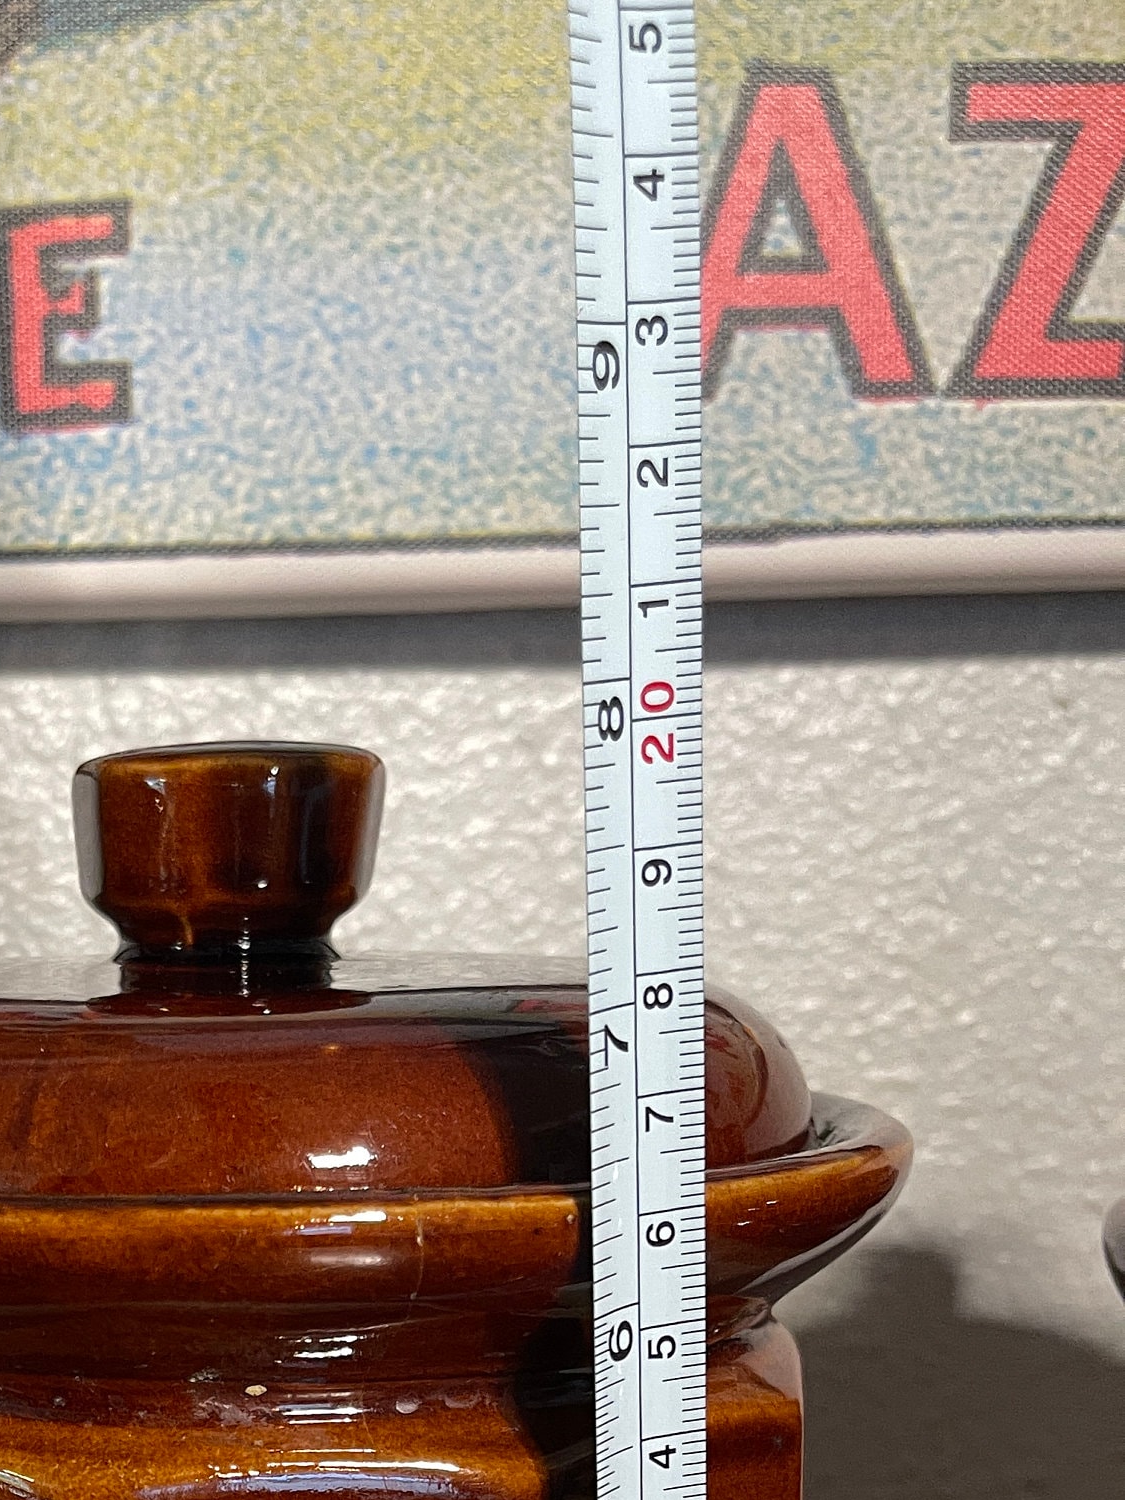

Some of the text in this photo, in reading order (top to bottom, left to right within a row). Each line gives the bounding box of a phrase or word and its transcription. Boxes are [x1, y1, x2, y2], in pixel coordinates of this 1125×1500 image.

[629, 22, 663, 53] 5
[633, 169, 665, 201] 4
[700, 58, 1125, 402] AZ
[635, 315, 669, 346] 3
[592, 340, 620, 391] 9
[637, 457, 669, 488] 2
[638, 599, 669, 619] 1
[598, 695, 624, 741] 8
[640, 681, 675, 765] 20
[641, 858, 672, 887] 9
[643, 982, 673, 1010] 8
[604, 1024, 629, 1067] 7
[645, 1106, 674, 1132] 7
[646, 1220, 675, 1248] 6
[609, 1320, 633, 1362] 6
[647, 1334, 677, 1360] 5
[648, 1444, 677, 1469] 4
